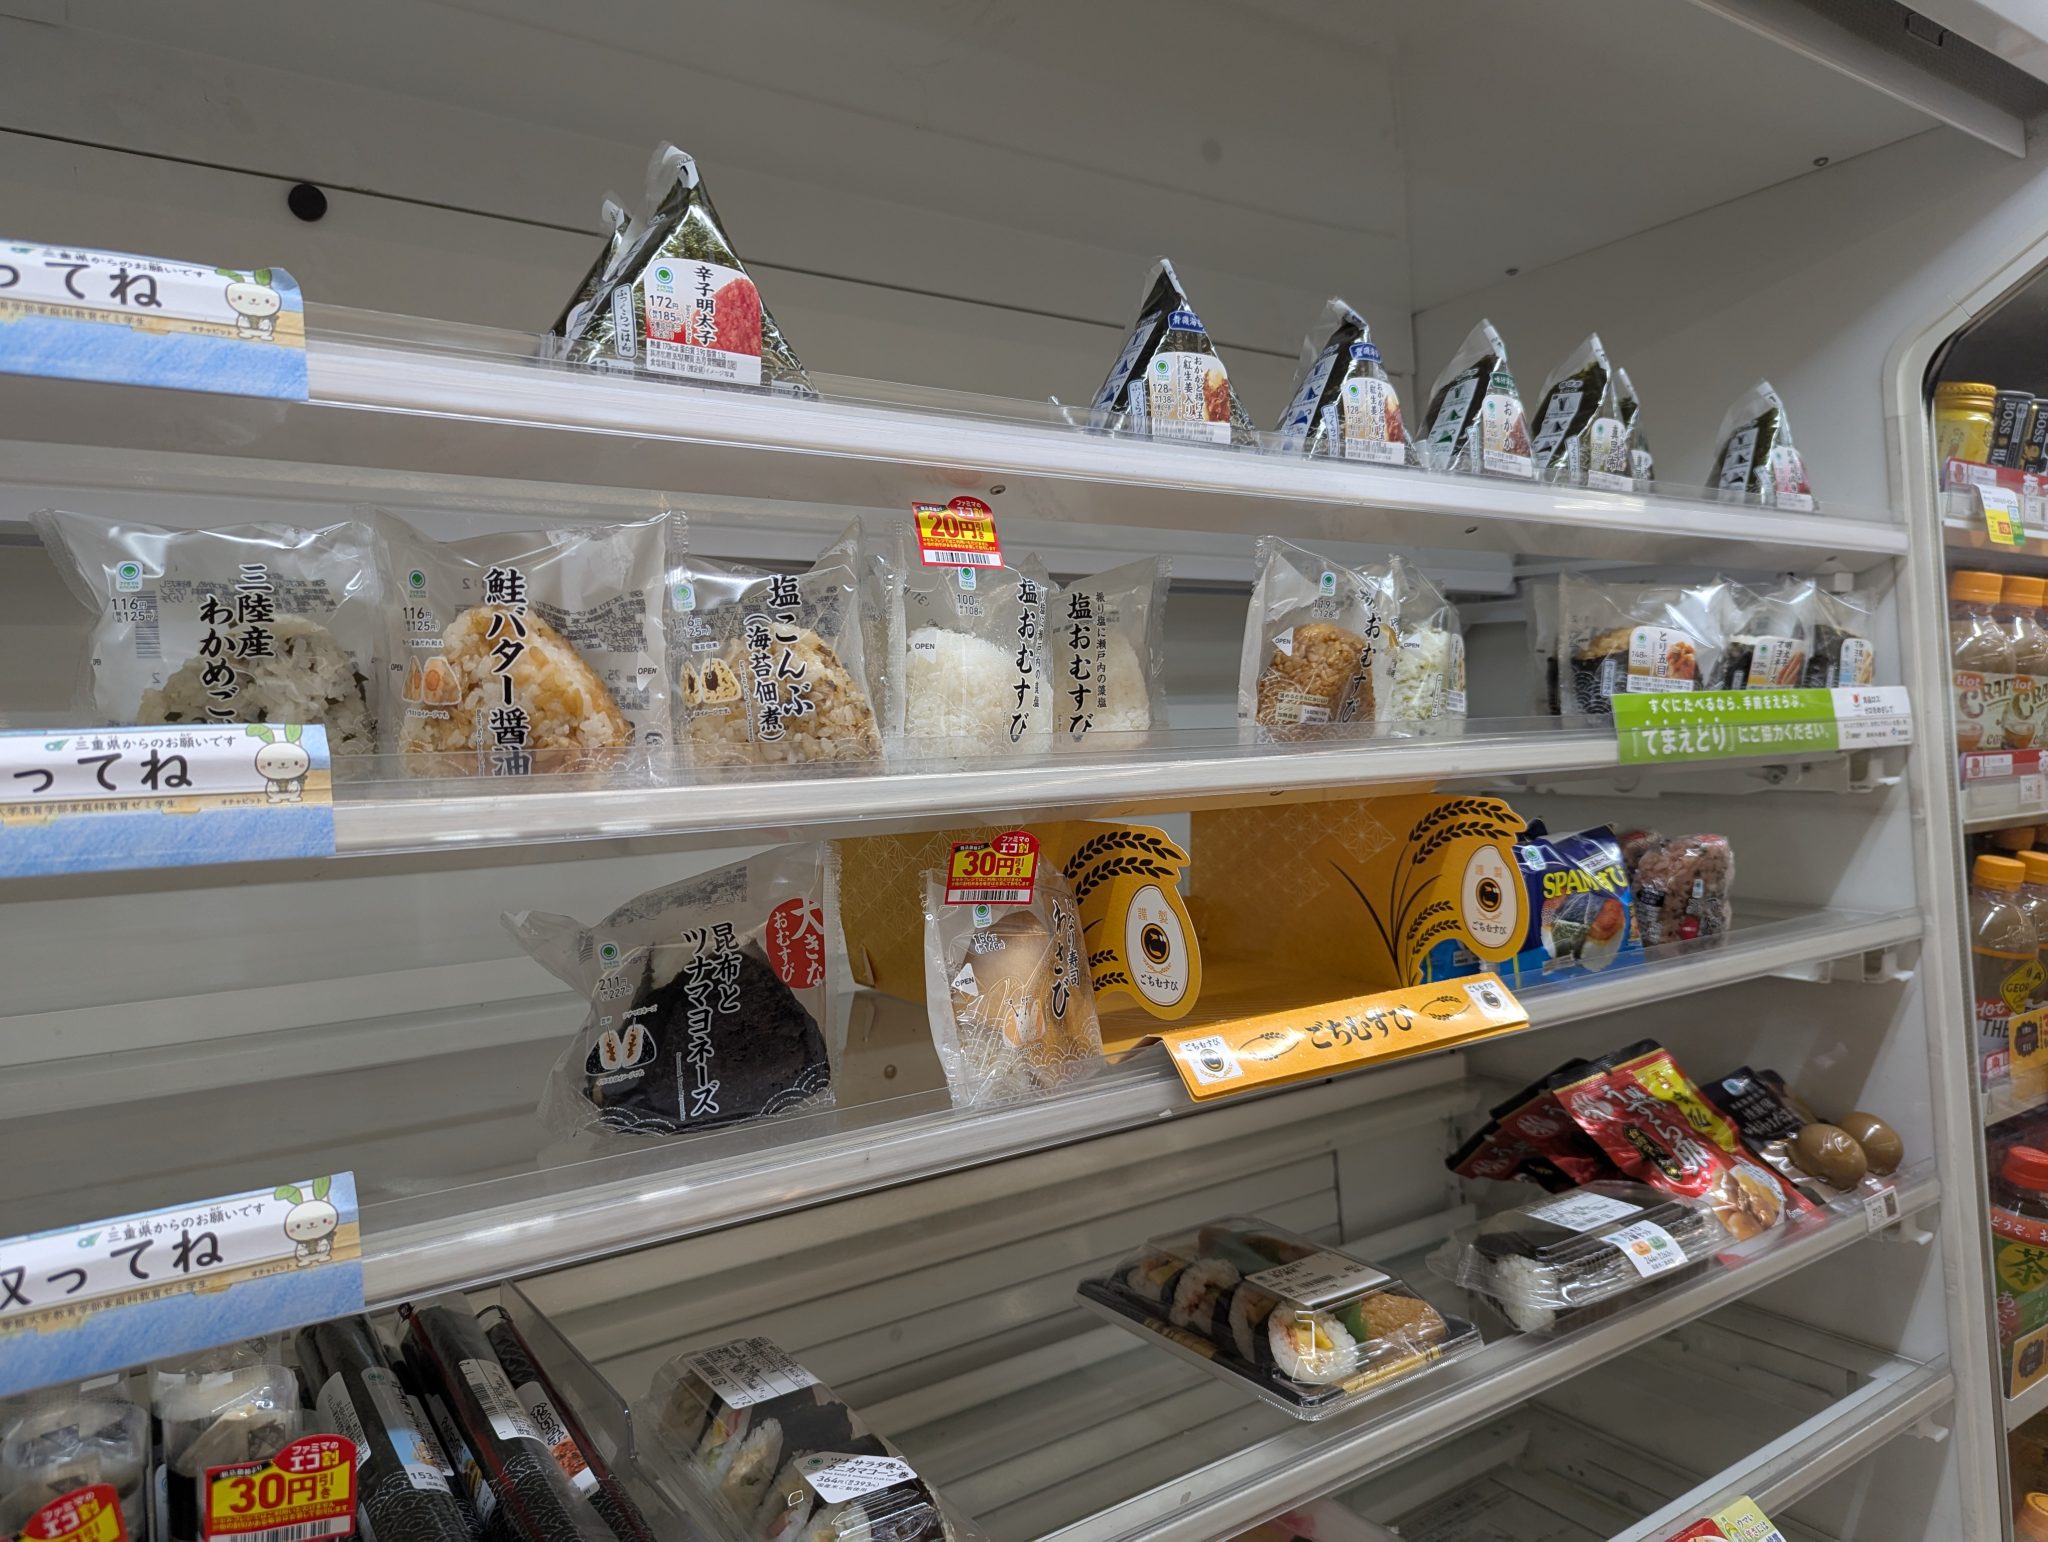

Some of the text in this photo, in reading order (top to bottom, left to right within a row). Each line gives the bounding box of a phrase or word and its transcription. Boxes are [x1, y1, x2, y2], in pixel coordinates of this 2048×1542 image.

[649, 294, 679, 310] 172円
[694, 265, 717, 346] 辛子明太子
[617, 289, 631, 352] ふっくらごはん
[1504, 401, 1514, 451] おかか
[2000, 402, 2016, 435] BOSS
[2033, 411, 2048, 443] BOSS
[928, 512, 977, 539] 20円
[111, 598, 147, 610] 116円
[235, 563, 275, 657] 三陸産
[403, 607, 432, 619] 116円
[200, 594, 237, 724] わかめご
[770, 575, 816, 717] 塩こんぶ
[915, 642, 935, 650] OPEN
[1275, 637, 1291, 645] OPEN
[1342, 589, 1381, 723] おむすび
[1657, 631, 1668, 677] とり五目
[638, 667, 657, 675] OPEN
[743, 613, 786, 743] (海苔佃煮)
[1009, 578, 1037, 743] 塩おむすび
[1067, 592, 1094, 743] 塩おむすび
[1956, 674, 1980, 687] Hot
[75, 735, 236, 751] 三重県からのお願いです
[14, 750, 192, 794] ってね
[962, 851, 1014, 877] 30円
[1000, 843, 1030, 854] エコ割
[773, 911, 795, 983] おむすび
[789, 897, 826, 988] 大きな
[711, 922, 741, 1014] 昆布と
[954, 976, 975, 987] OPEN
[1139, 973, 1178, 991] ごちむすび
[682, 926, 720, 1118] ツナマヨネーズ
[1304, 1004, 1414, 1050] ごちむすび
[107, 1202, 265, 1243] 三重県からのお願いです
[290, 1449, 340, 1472] エコ割
[291, 1441, 339, 1455] ファミマの
[830, 1457, 907, 1471] ツナサラダ巻と
[319, 1471, 334, 1499] 引き
[826, 1464, 909, 1479] カニカマコーン巻
[229, 1472, 318, 1514] 30円
[42, 1499, 101, 1538] エコ割
